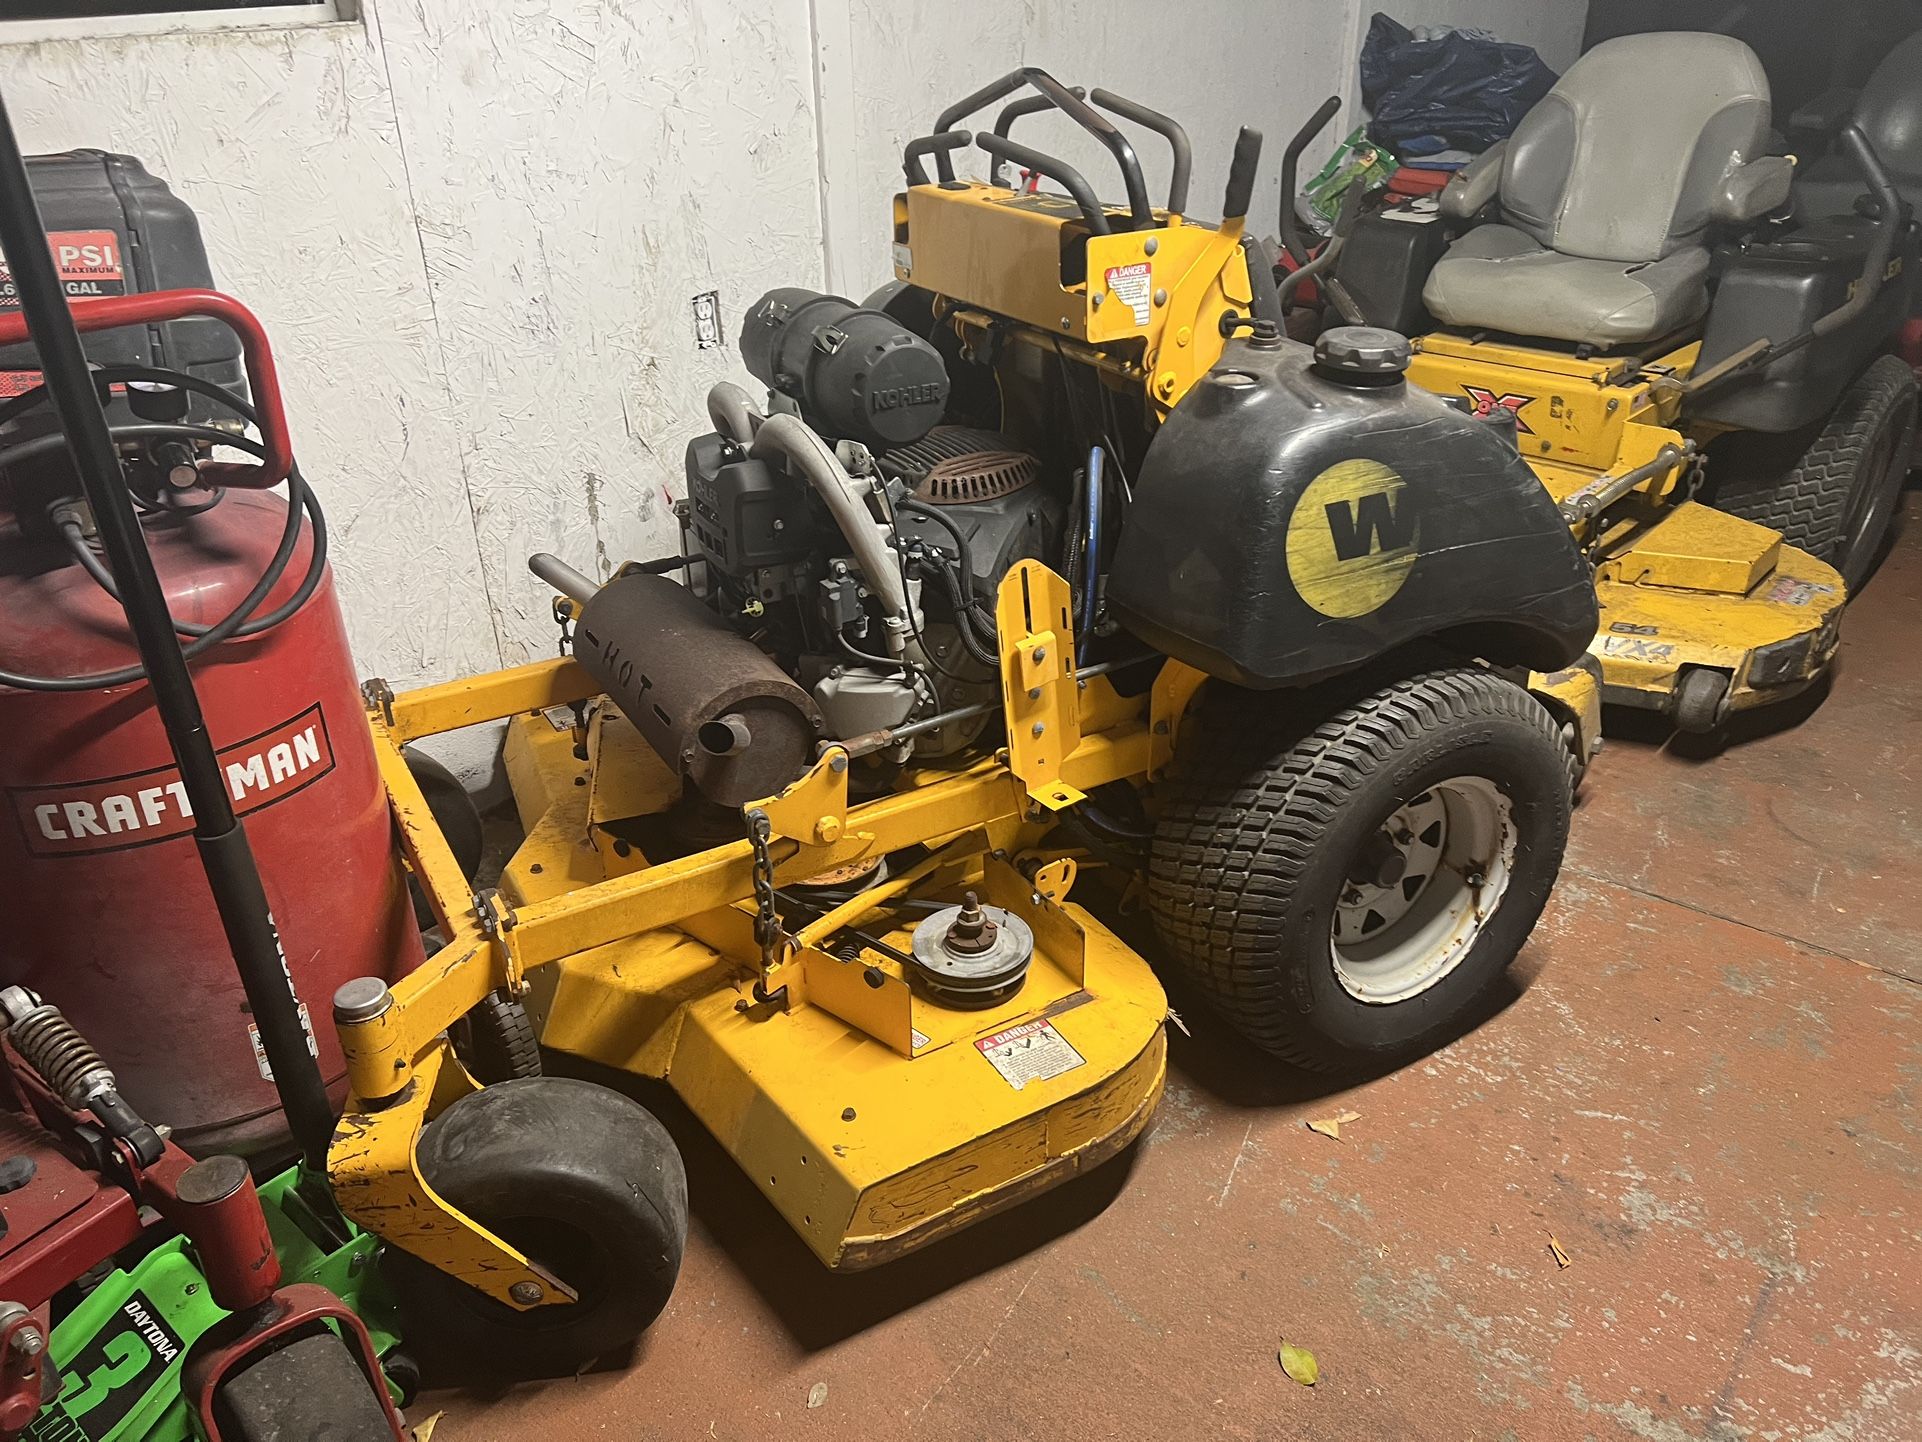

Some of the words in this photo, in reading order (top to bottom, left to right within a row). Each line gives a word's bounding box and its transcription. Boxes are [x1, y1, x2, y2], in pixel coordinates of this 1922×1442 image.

[58, 244, 114, 267] PSI
[1119, 264, 1147, 278] DANGER
[65, 281, 103, 295] GAL
[872, 383, 940, 411] KOHLER
[1324, 487, 1419, 562] W
[1608, 621, 1659, 636] 54
[601, 640, 653, 705] HOT
[33, 726, 321, 842] CRAFTMAN
[993, 1020, 1043, 1044] DANGER
[123, 1300, 179, 1364] DAYTONA
